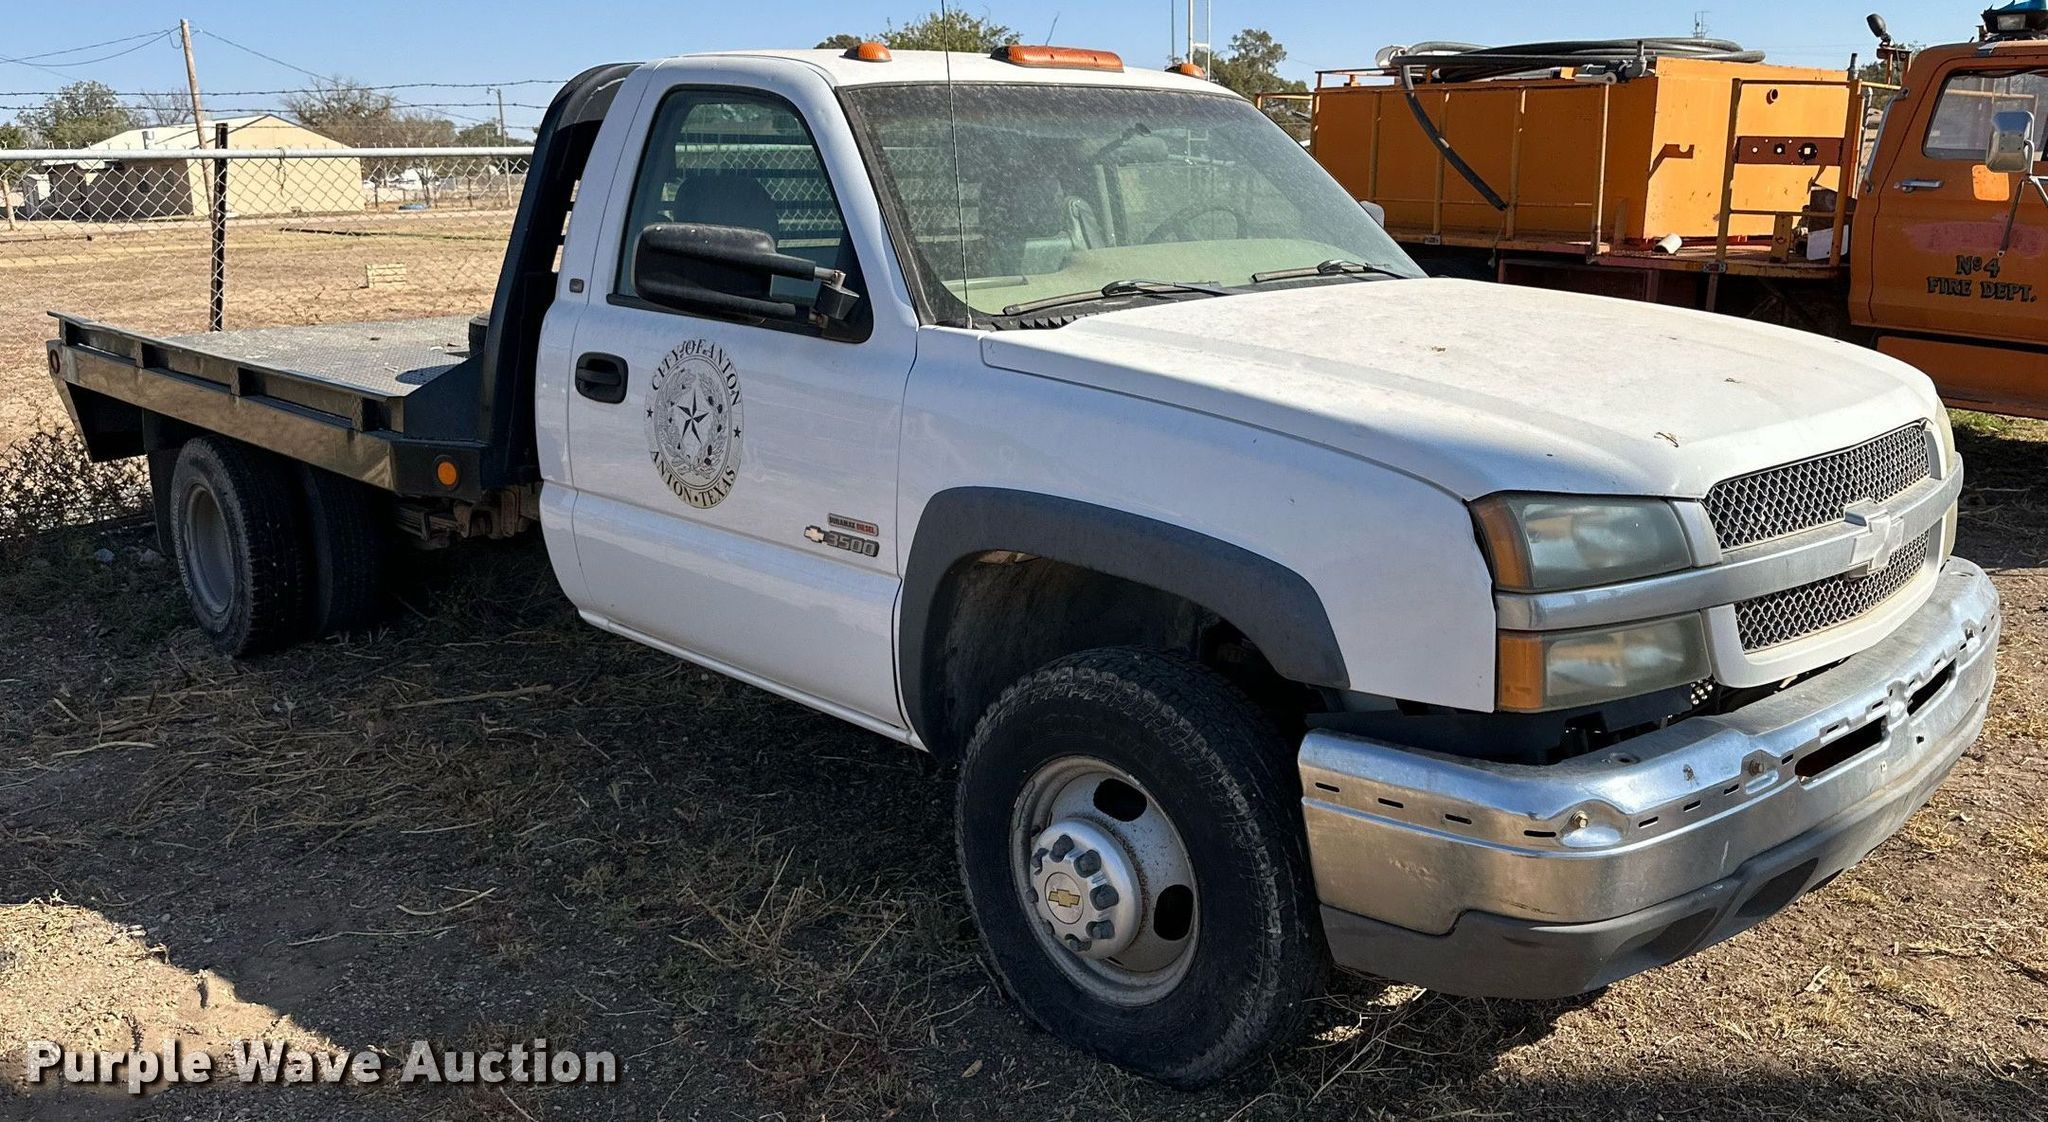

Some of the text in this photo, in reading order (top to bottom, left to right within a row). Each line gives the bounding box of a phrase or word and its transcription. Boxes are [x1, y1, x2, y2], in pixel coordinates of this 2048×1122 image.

[1983, 258, 2000, 278] 4
[1927, 276, 2037, 303] FIRE DEPT.
[652, 338, 742, 407] CITY OF ANTON
[650, 451, 736, 507] ANTON TEXAS
[825, 531, 878, 557] 3500
